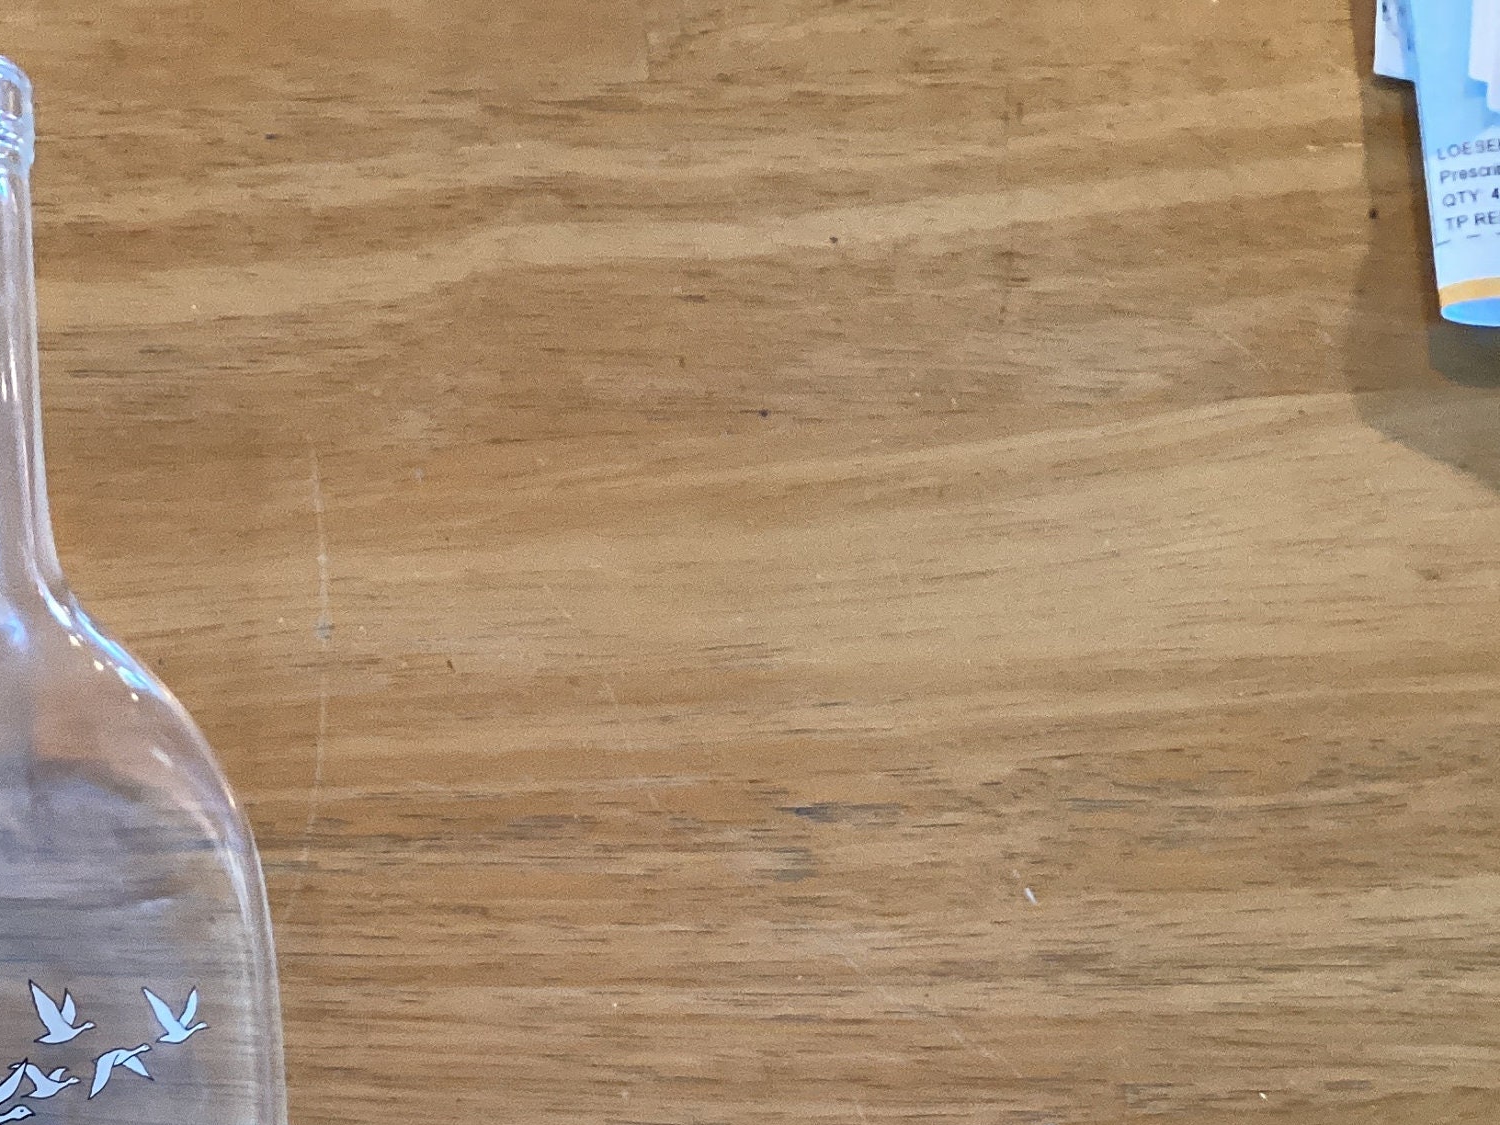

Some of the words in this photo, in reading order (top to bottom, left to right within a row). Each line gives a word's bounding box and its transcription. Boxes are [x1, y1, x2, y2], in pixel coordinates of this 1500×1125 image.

[1436, 138, 1500, 161] LOESE
[1442, 188, 1480, 208] QTY
[1444, 214, 1469, 231] TP
